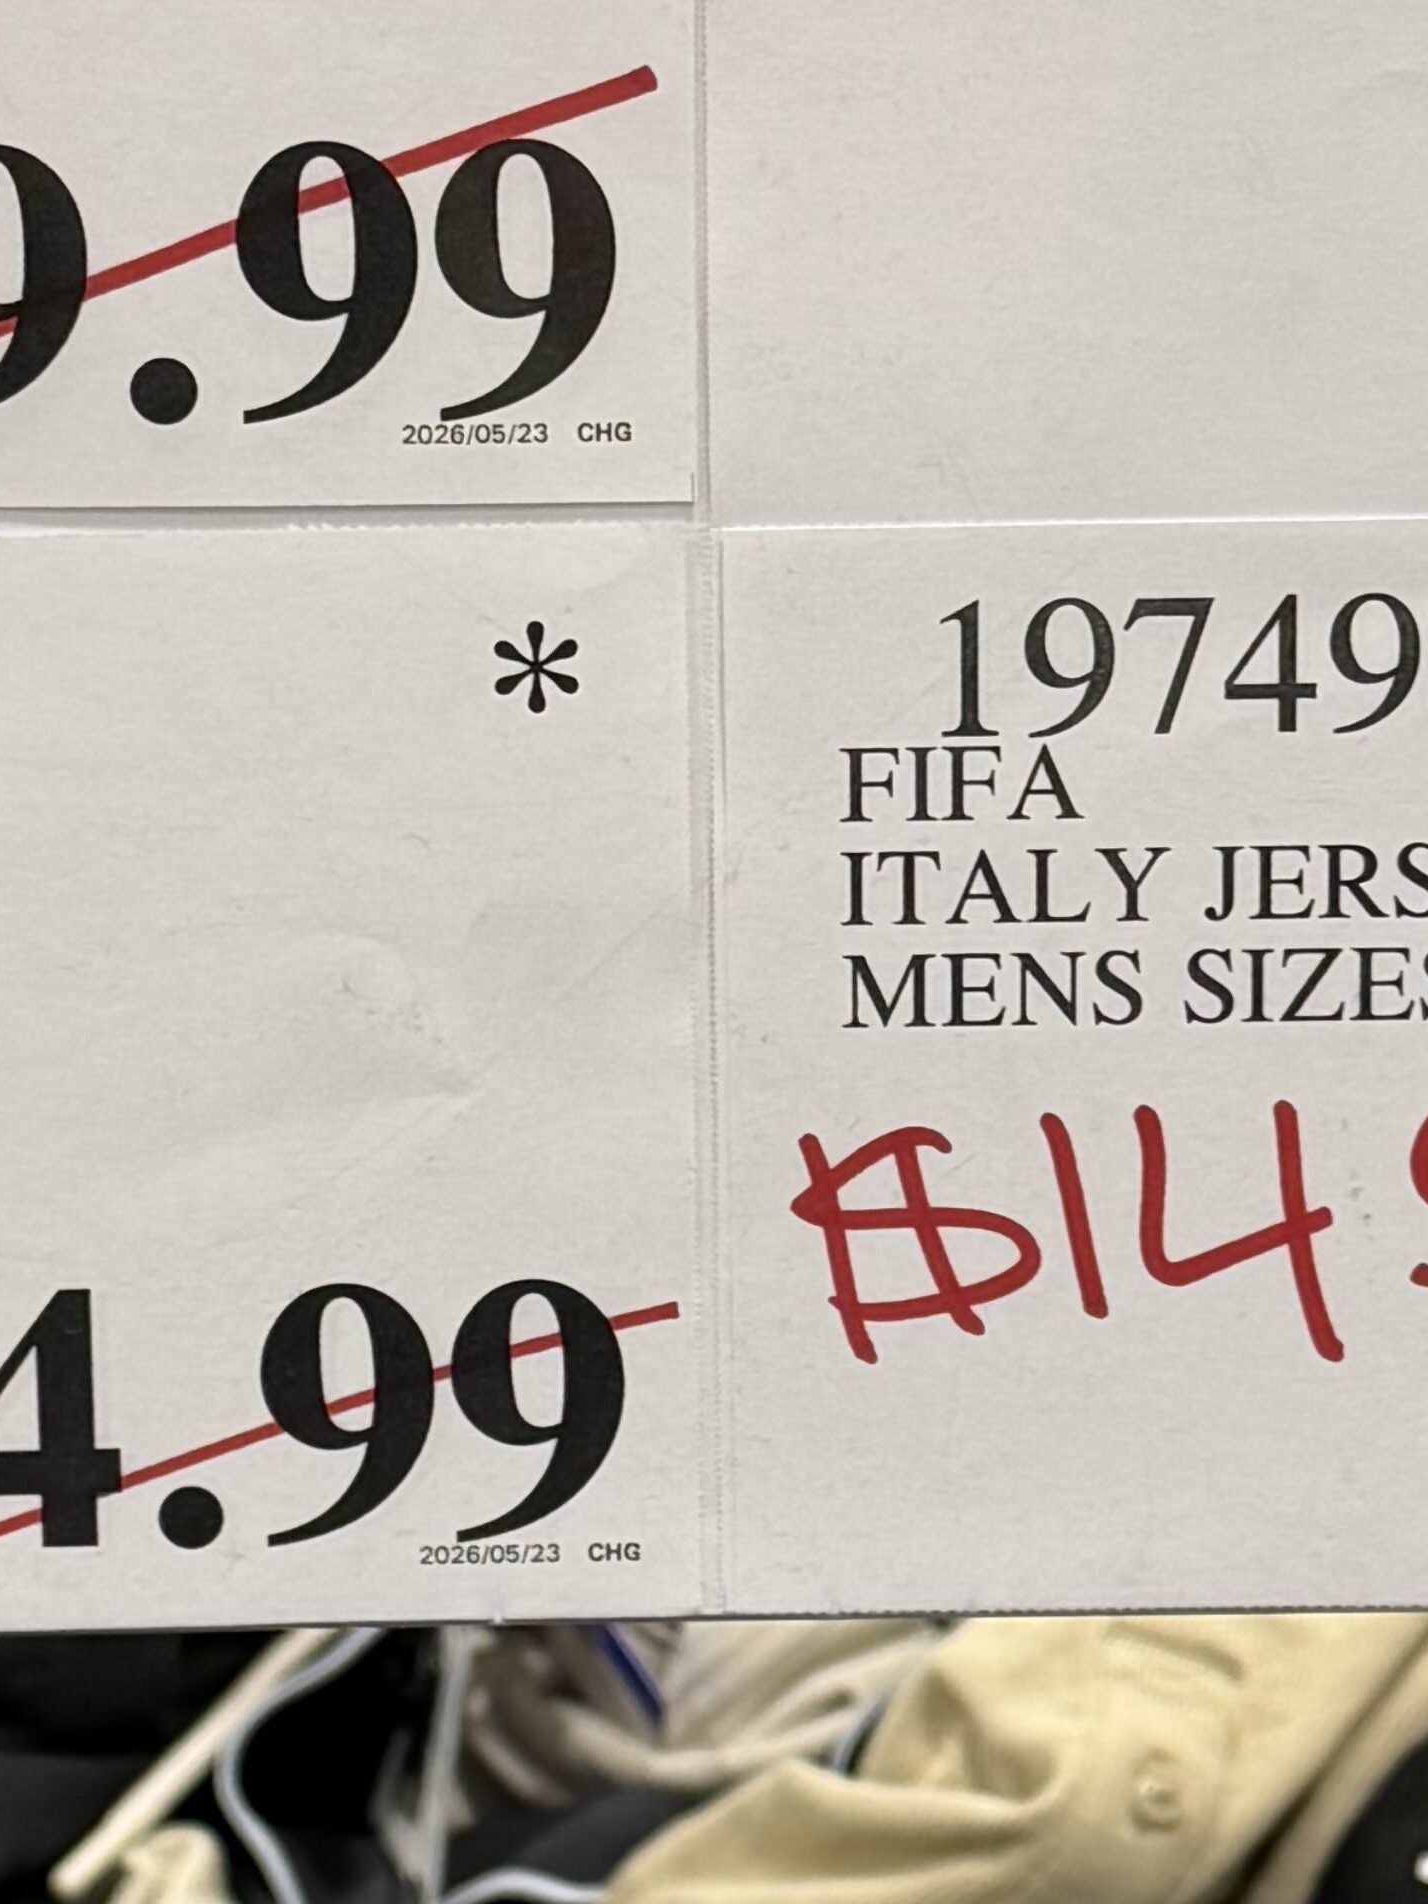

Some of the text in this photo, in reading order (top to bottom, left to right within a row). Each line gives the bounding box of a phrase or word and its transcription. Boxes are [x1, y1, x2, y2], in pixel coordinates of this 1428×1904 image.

[401, 421, 633, 446] 2026/05/23 CHG
[838, 742, 1086, 824] FIFA
[839, 845, 1172, 927] ITALY
[841, 948, 1144, 1030] MENS
[420, 1541, 641, 1566] 2026/05/23 CHG
